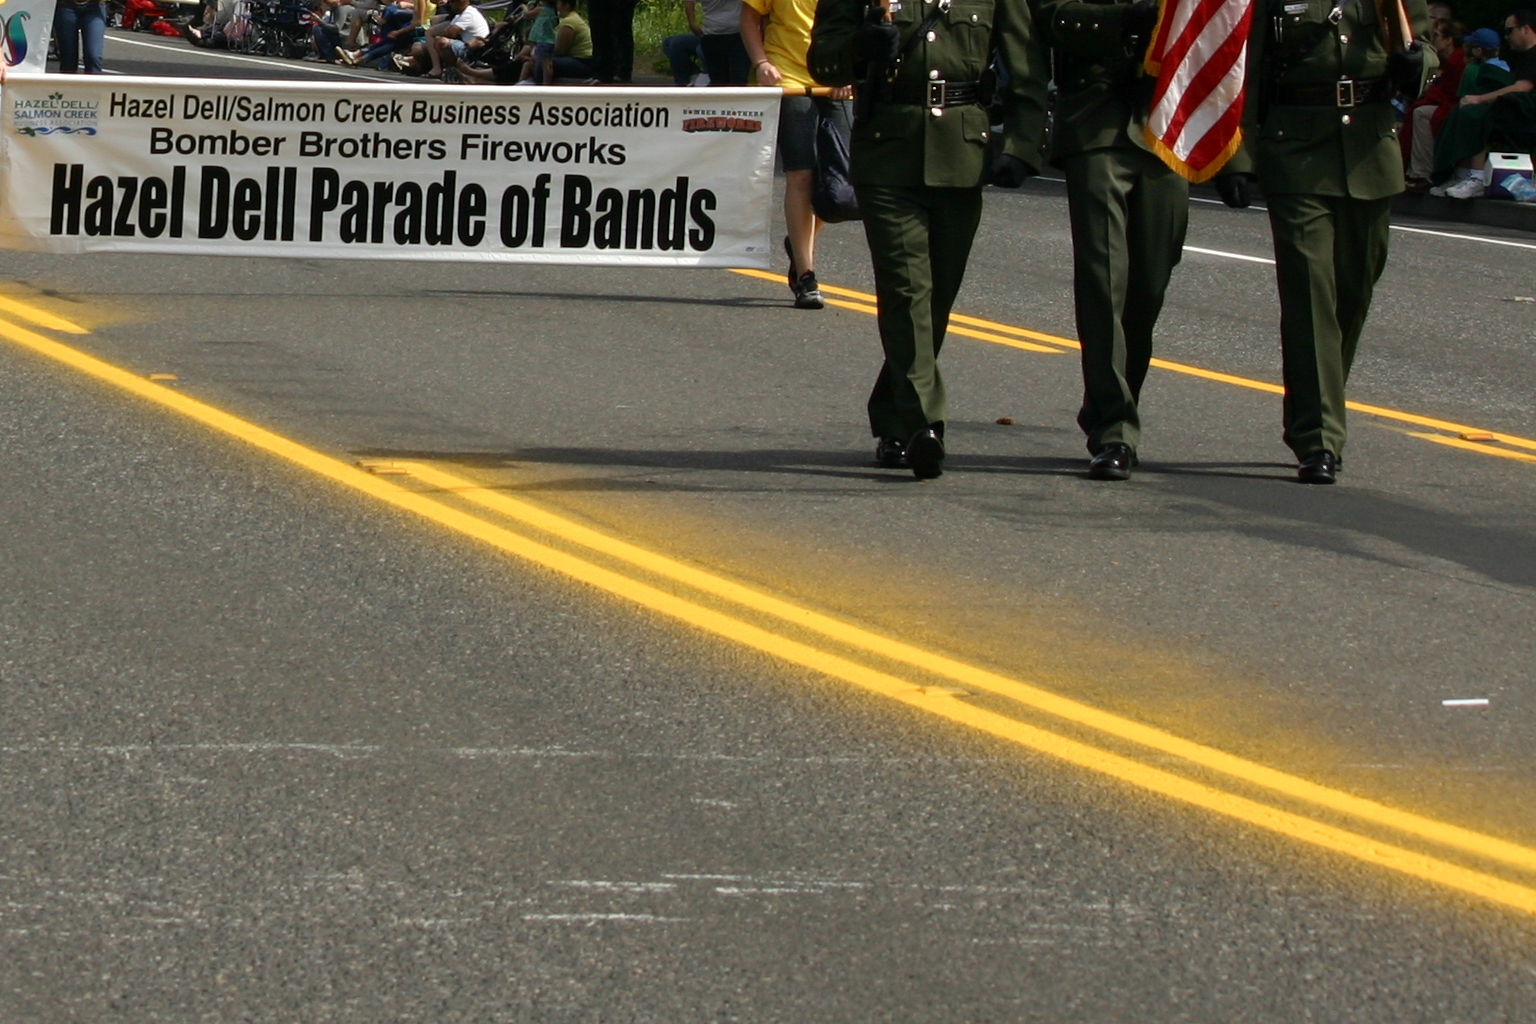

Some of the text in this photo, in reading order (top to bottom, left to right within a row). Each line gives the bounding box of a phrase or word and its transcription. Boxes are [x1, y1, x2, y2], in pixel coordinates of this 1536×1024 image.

[14, 99, 58, 109] HAZEL
[14, 110, 98, 120] SALMON CREEK
[109, 92, 669, 128] Hazel Dell/Salmon Creek Business Association
[150, 127, 627, 165] Bomber Brothers Fireworks
[49, 163, 717, 252] Hazel Dell Parade of Bands
